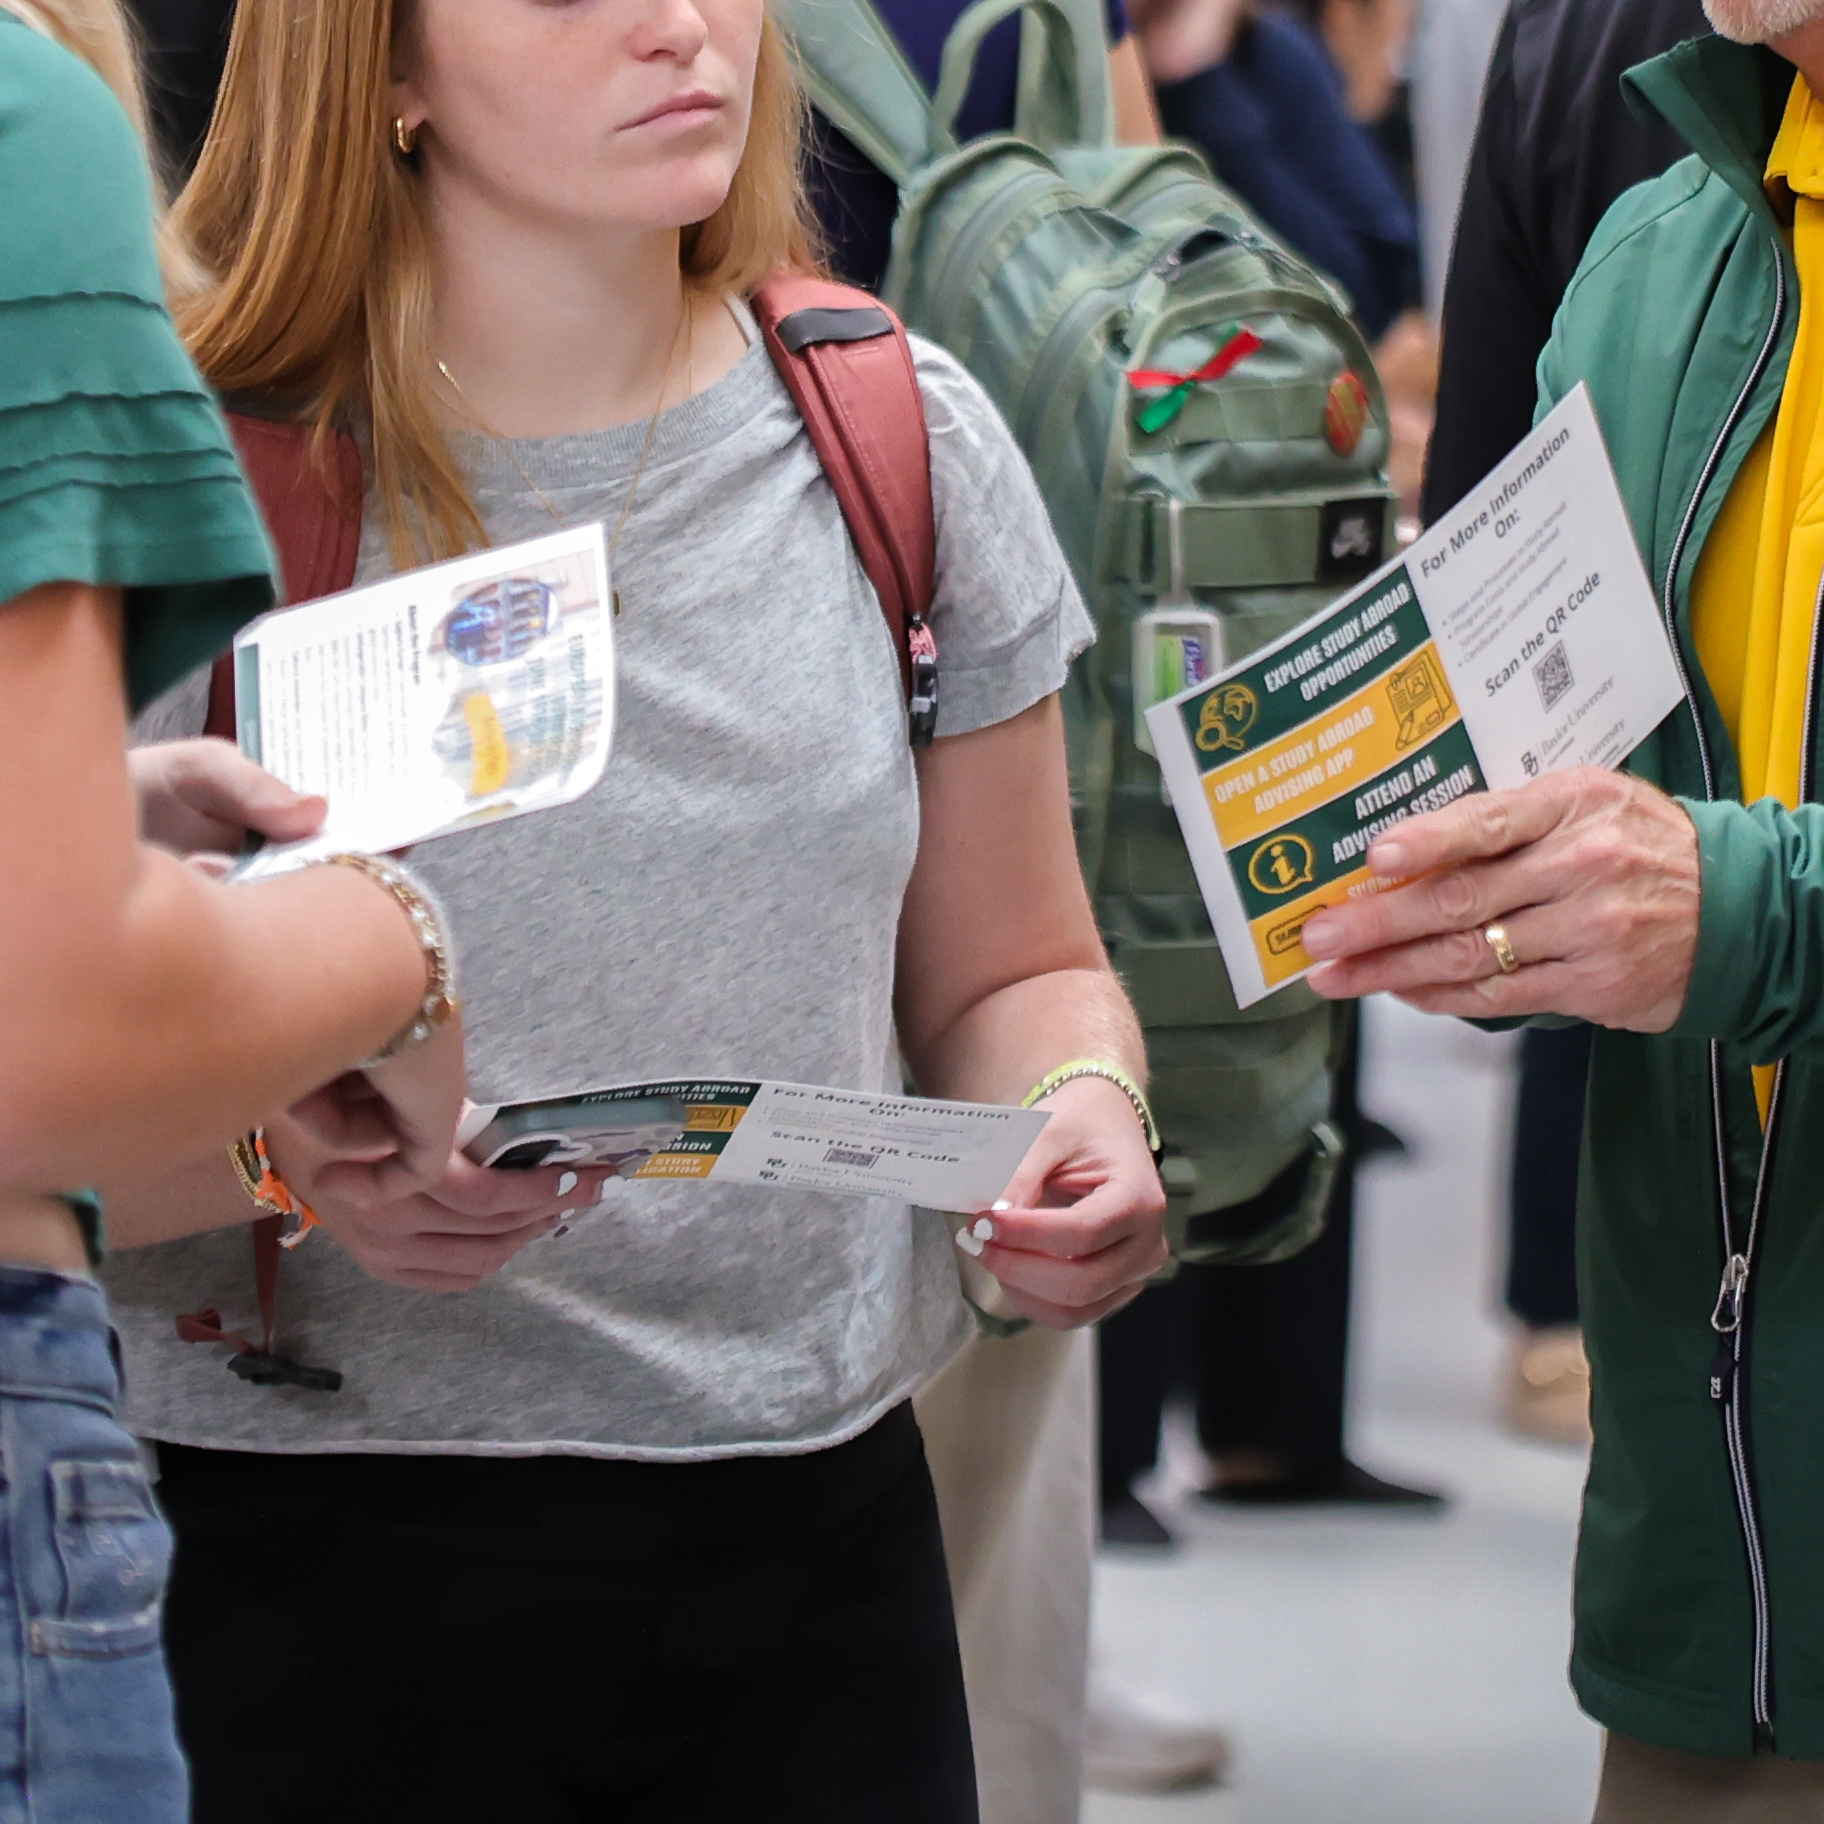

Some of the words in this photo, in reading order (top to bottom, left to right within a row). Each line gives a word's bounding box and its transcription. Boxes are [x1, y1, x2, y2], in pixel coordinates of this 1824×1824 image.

[1420, 549, 1448, 579] For
[1449, 510, 1489, 554] More
[1489, 426, 1570, 516] Information
[1494, 509, 1521, 539] On:
[1263, 644, 1323, 693] EXPLORE
[1321, 619, 1363, 658] STUDY
[1360, 582, 1411, 632] ABROAD
[1299, 624, 1398, 702] OPPORTUNITIES
[1485, 657, 1520, 697] Scan
[1521, 631, 1545, 661] the
[1545, 606, 1569, 635] QR
[1567, 572, 1600, 613] Code
[1214, 769, 1256, 804] OPEN
[1257, 765, 1270, 785] A
[1269, 741, 1316, 778] STUDY
[1317, 705, 1374, 753] ABROAD
[1254, 764, 1326, 814] ADVISING
[1325, 747, 1356, 778] APP
[1355, 771, 1415, 820] ATTEND
[1412, 754, 1438, 788] AN
[1409, 764, 1476, 816] SESSION
[774, 1088, 807, 1098] For
[815, 1093, 871, 1106] More
[878, 1101, 1010, 1120] Information
[770, 1130, 821, 1144] Scan
[828, 1139, 863, 1149] the
[870, 1146, 900, 1156] QR
[907, 1151, 960, 1163] Code
